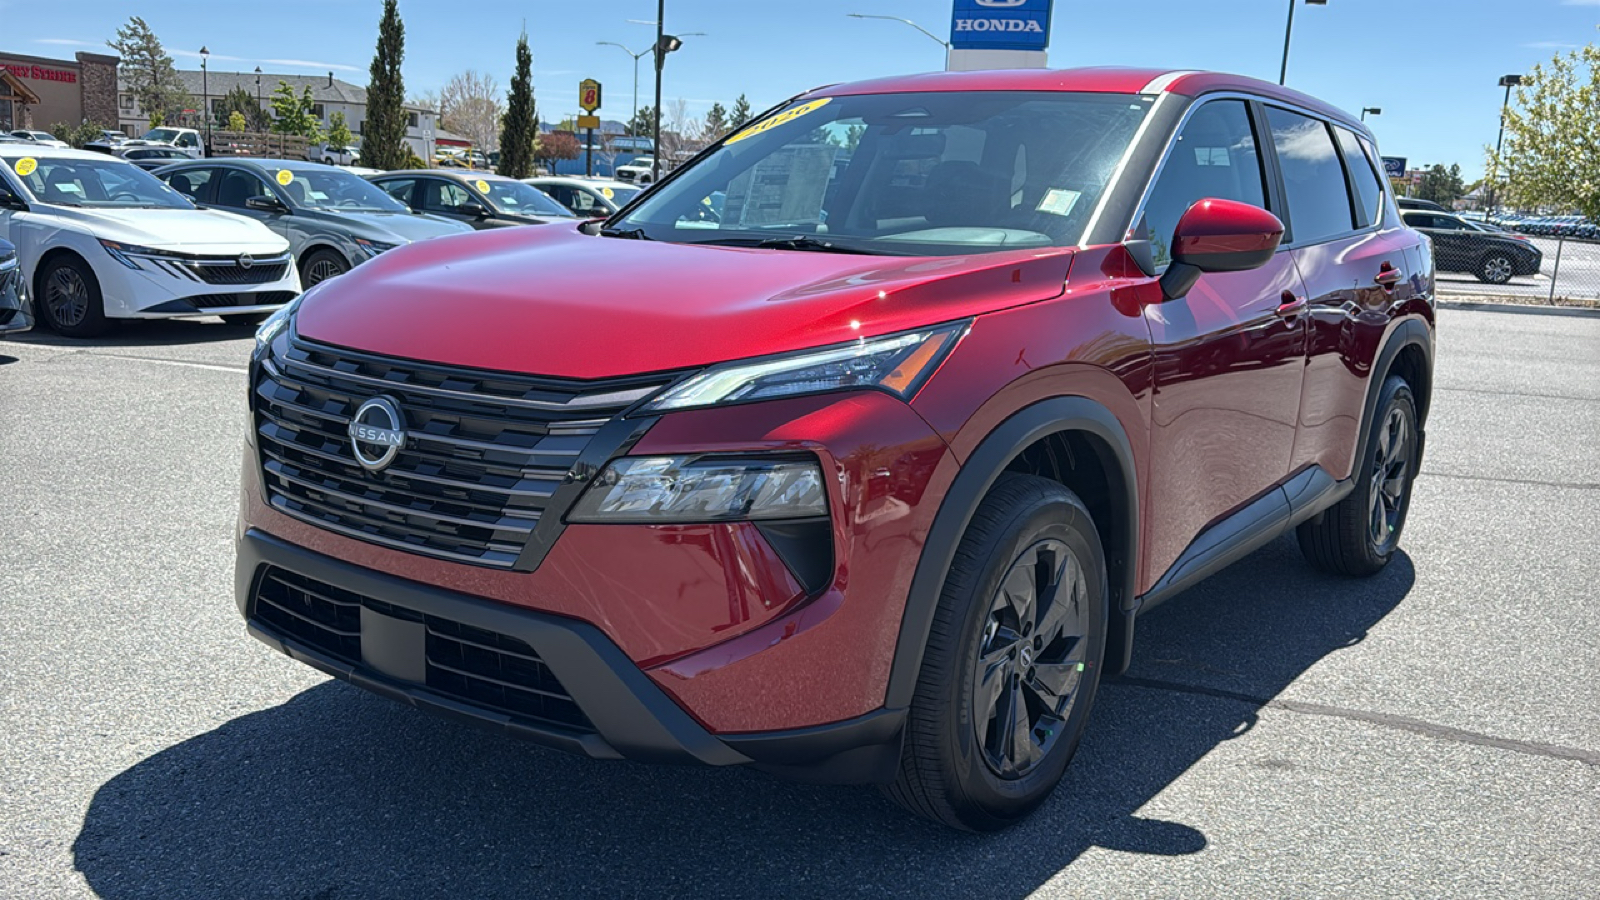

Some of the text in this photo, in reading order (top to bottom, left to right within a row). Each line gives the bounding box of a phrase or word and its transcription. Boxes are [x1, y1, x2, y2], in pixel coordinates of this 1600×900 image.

[955, 18, 1043, 32] HONDA
[31, 65, 76, 83] STRIKE
[584, 90, 596, 104] 8
[750, 106, 810, 134] 2026
[349, 424, 402, 444] NISSAN
